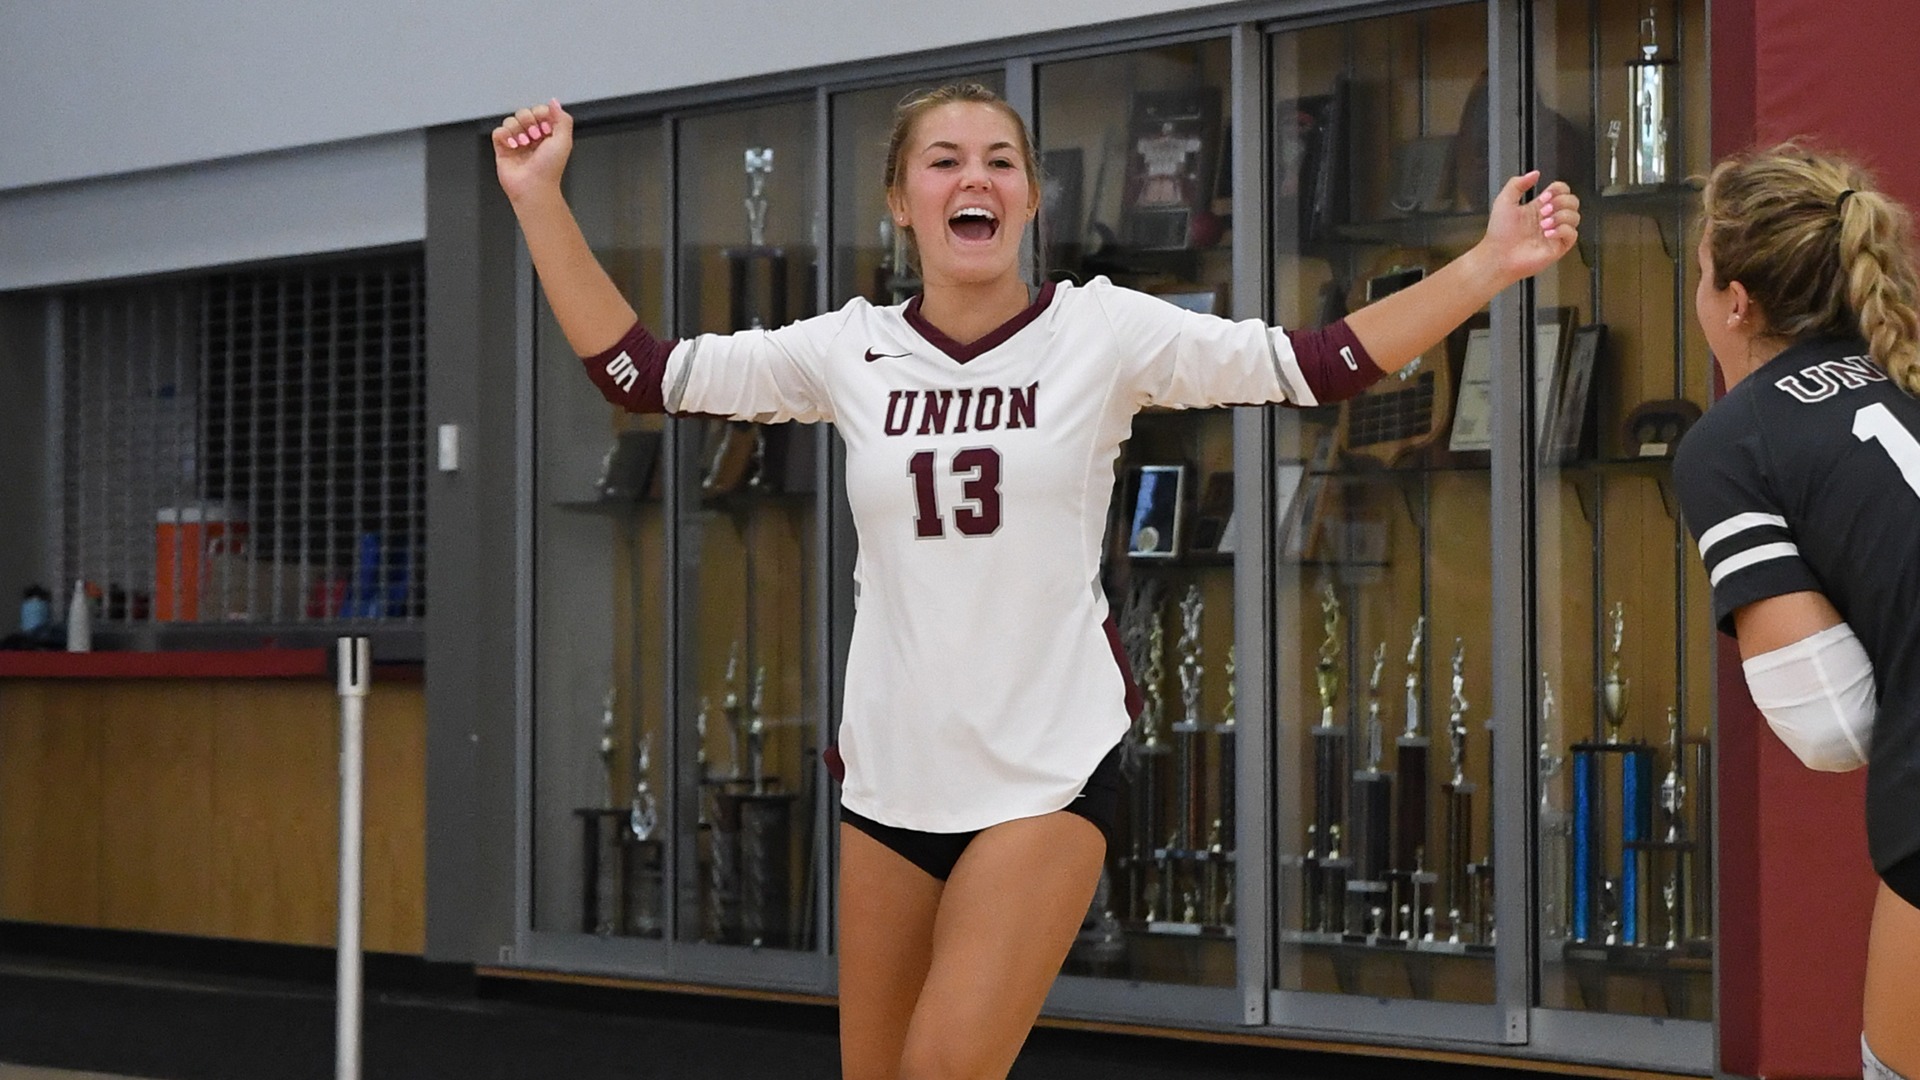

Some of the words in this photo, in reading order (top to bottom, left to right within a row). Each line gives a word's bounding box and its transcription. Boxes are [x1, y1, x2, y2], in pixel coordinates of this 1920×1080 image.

[884, 379, 1040, 437] UNION
[1774, 355, 1888, 403] UN
[906, 444, 1004, 541] 13
